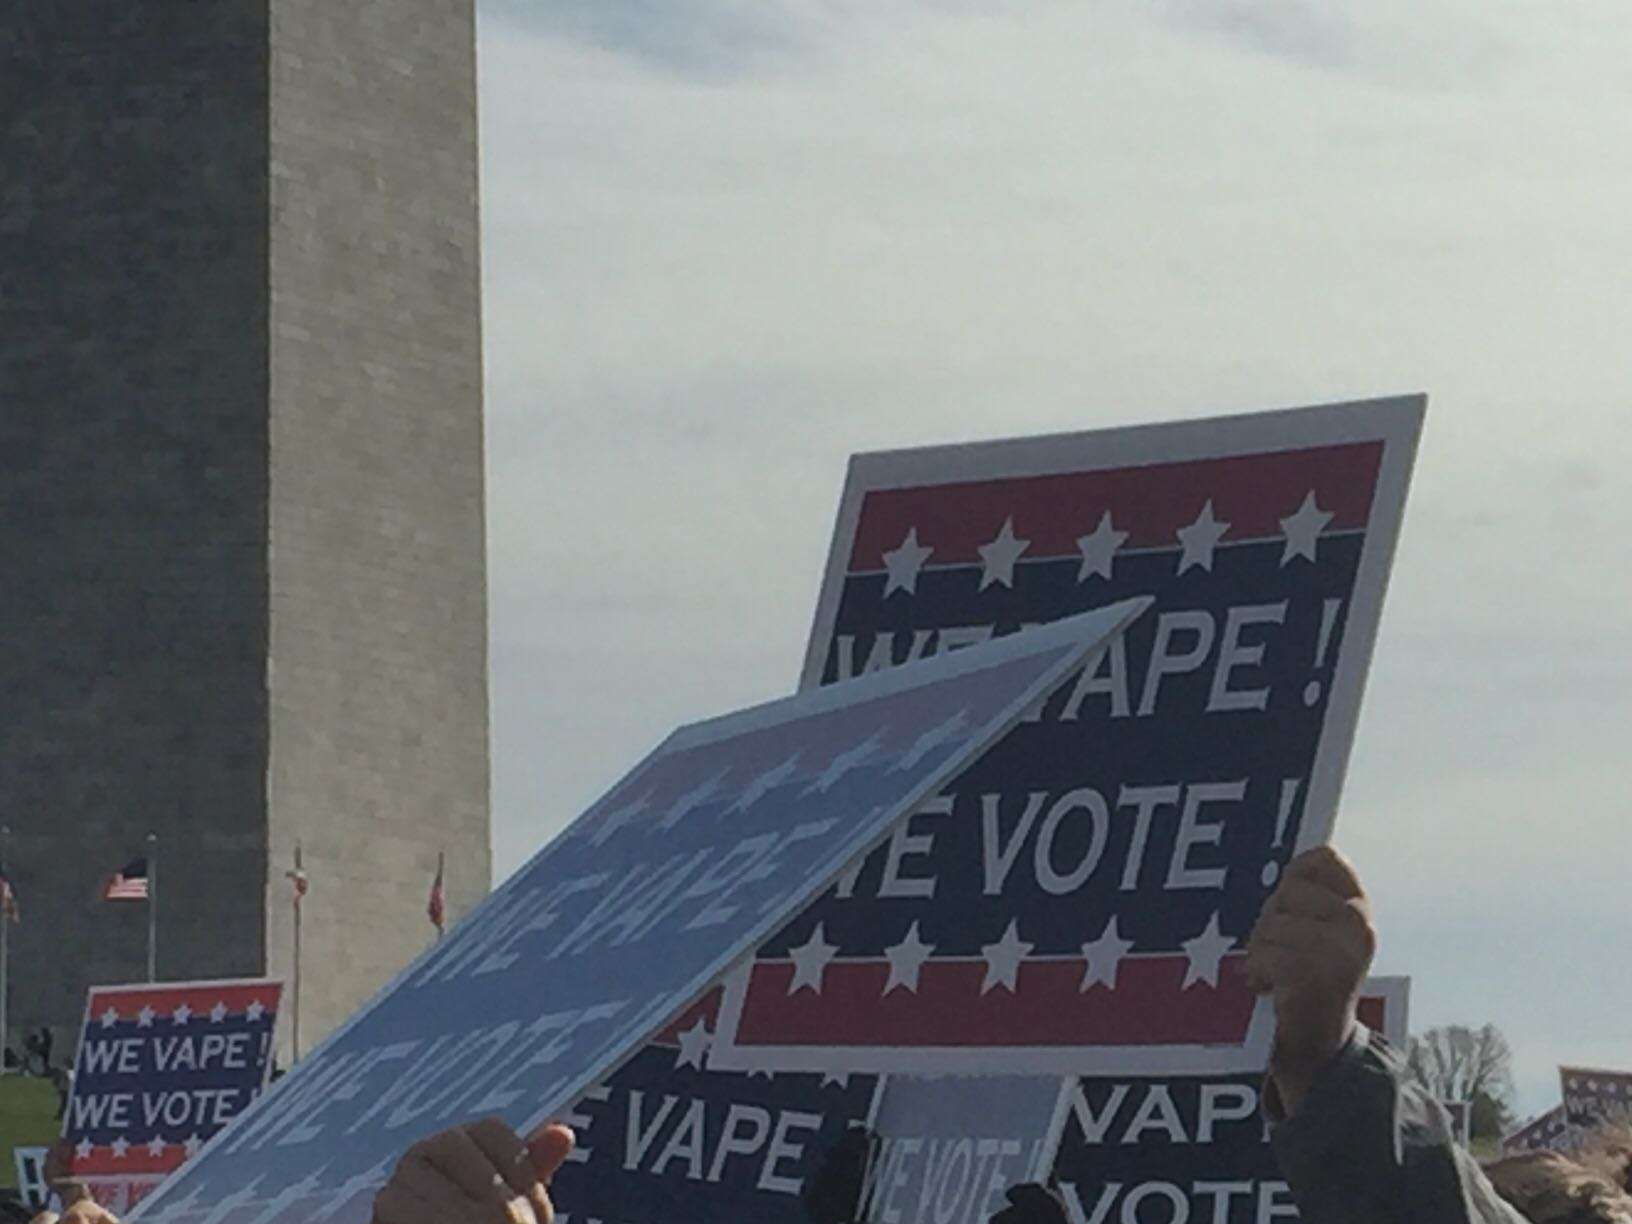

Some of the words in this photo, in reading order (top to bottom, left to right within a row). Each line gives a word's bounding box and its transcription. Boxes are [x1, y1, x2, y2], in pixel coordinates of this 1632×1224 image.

[1010, 599, 1291, 722] APE
[835, 795, 959, 898] E
[981, 778, 1250, 896] VOTE
[84, 1037, 144, 1073] WE
[154, 1032, 249, 1071] VAPE
[74, 1093, 133, 1130] WE
[142, 1089, 240, 1126] VOTE
[622, 1086, 822, 1193] VAPE
[1072, 1084, 1272, 1144] VAP
